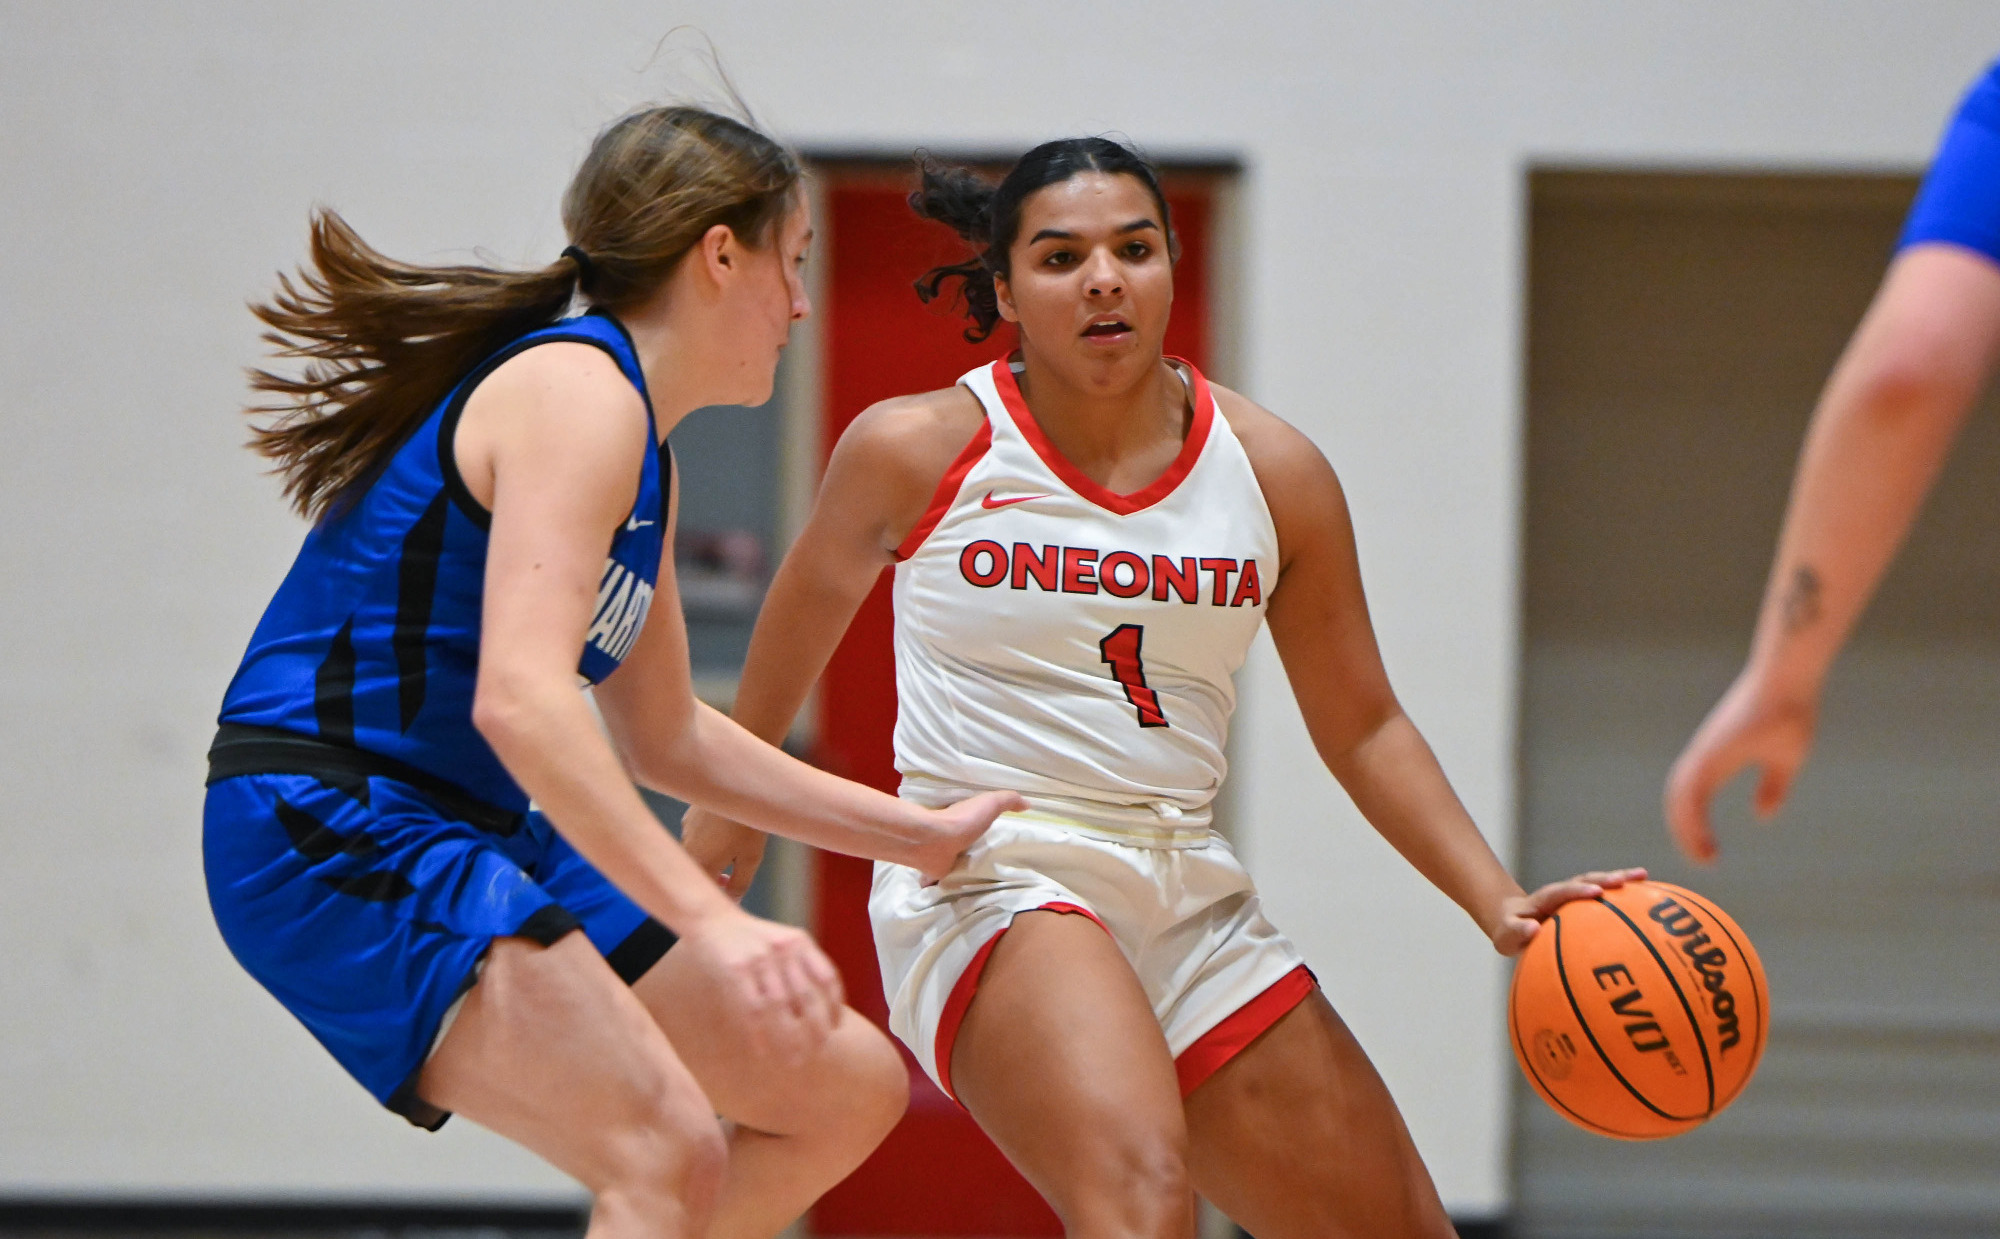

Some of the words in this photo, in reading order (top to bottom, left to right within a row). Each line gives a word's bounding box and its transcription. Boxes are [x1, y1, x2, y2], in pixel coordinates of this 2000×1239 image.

[959, 539, 1261, 608] ONEONTA
[1099, 623, 1170, 728] 1
[1592, 963, 1670, 1053] EVO
[1648, 897, 1741, 1056] Wilson
